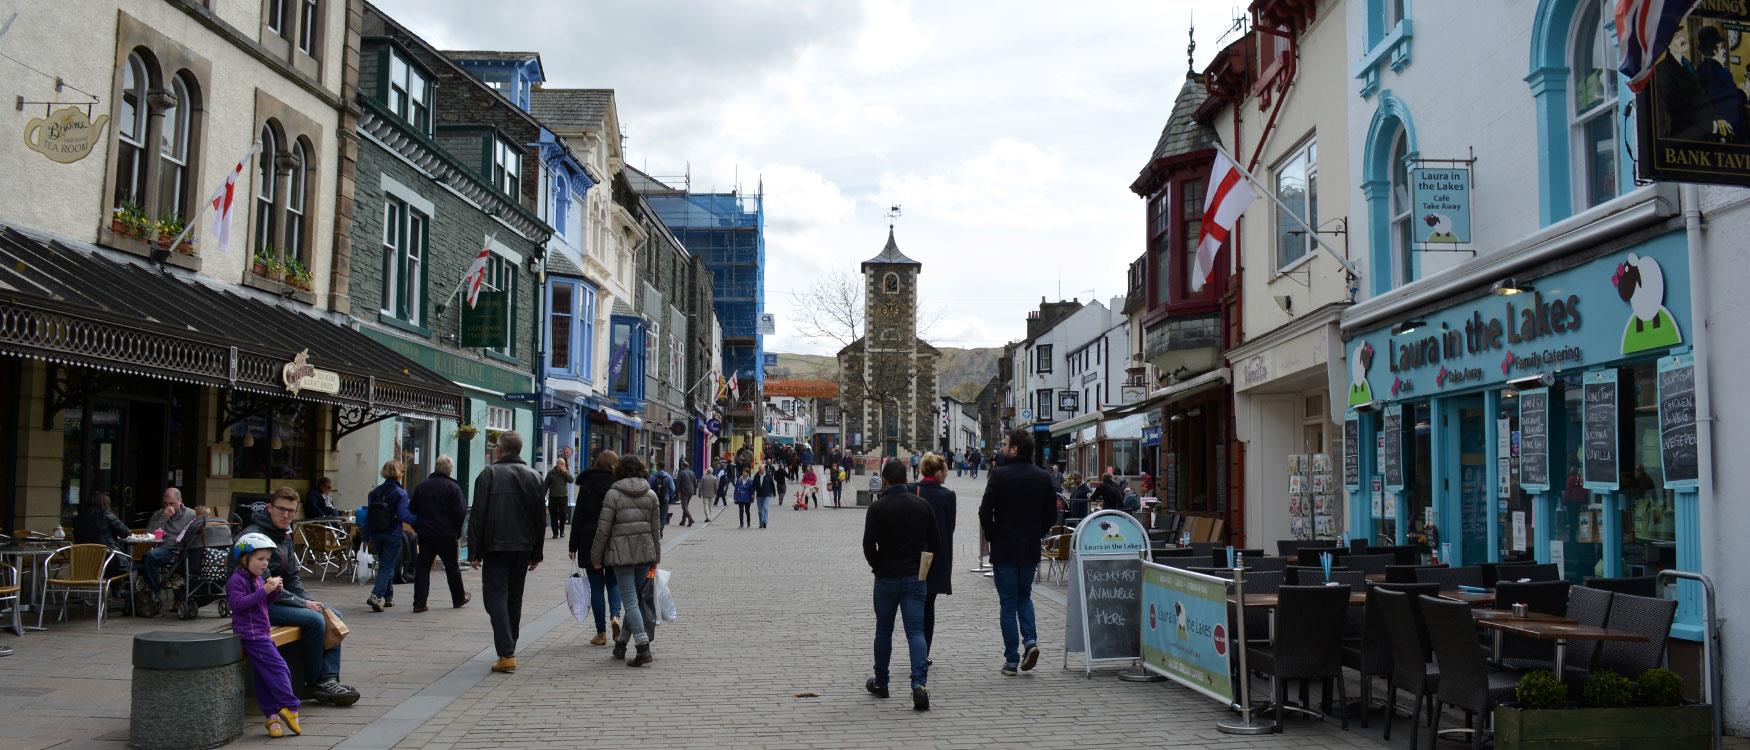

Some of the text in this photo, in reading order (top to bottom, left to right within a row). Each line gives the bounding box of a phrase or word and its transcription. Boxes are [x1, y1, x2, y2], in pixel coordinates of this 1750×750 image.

[1698, 0, 1747, 16] NNINGS
[45, 141, 88, 153] TEA ROOM
[1665, 148, 1711, 167] BANK
[1422, 171, 1460, 180] Laura in
[1419, 182, 1464, 190] the Lakes
[1423, 202, 1461, 211] Take Away
[1389, 291, 1582, 373] Laura in the Lakes
[1515, 345, 1580, 370] Family Catering
[1448, 367, 1482, 384] Take Away
[1664, 396, 1692, 411] CHICKEN
[1671, 408, 1689, 424] VEG
[1664, 433, 1697, 449] VEGETABL
[1086, 568, 1138, 582] BREAKFAST
[1089, 586, 1135, 601] AVAILABLE
[1094, 608, 1127, 626] HERE
[1158, 609, 1172, 624] Laura
[1196, 617, 1212, 639] Lakes
